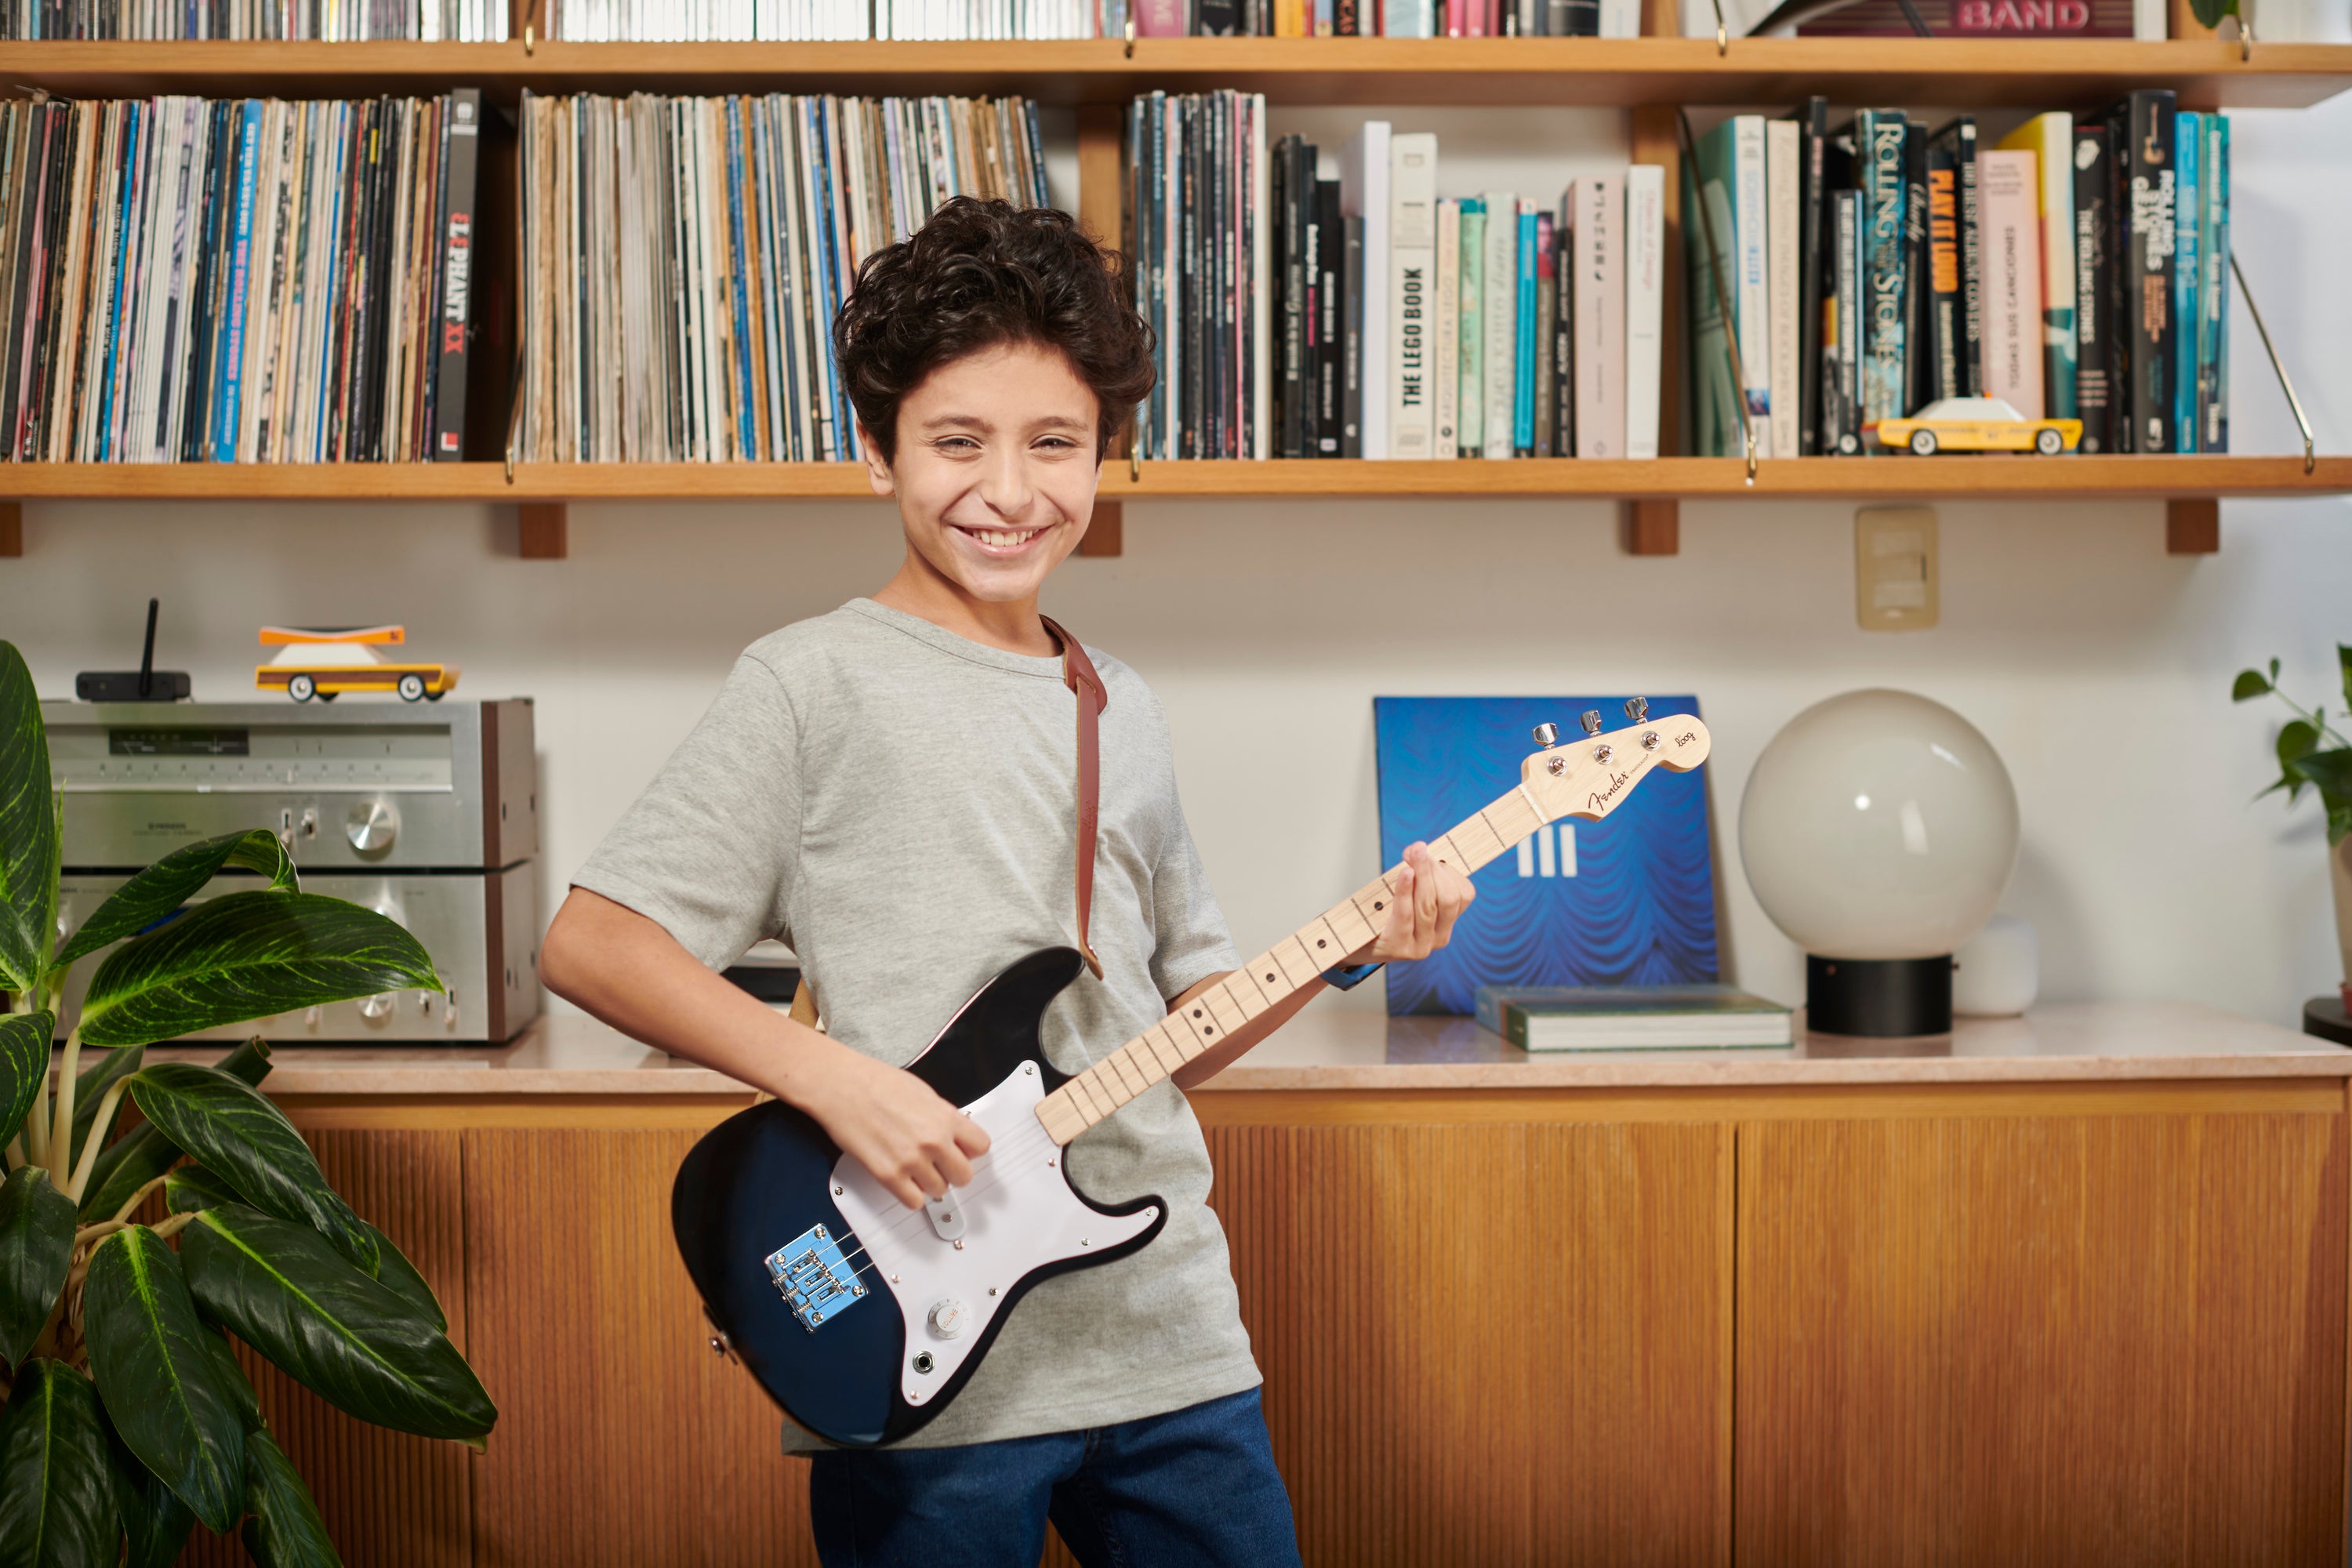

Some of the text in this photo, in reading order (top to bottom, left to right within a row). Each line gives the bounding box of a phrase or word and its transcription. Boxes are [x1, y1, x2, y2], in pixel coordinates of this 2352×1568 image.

[1960, 0, 2089, 30] BAND
[1873, 123, 1904, 238] ROLLING
[2132, 176, 2149, 234] GEAR
[2159, 169, 2176, 256] ROLLING
[237, 239, 247, 267] THE
[1928, 169, 1958, 294] PLAY IT LOUD
[231, 268, 245, 328] ROLLING
[444, 212, 470, 356] ELEPHANT XX
[227, 329, 238, 381] STONES
[1403, 267, 1421, 407] THE LEGO BOOK
[1873, 272, 1903, 370] STONES
[1588, 771, 1628, 811] Fender
